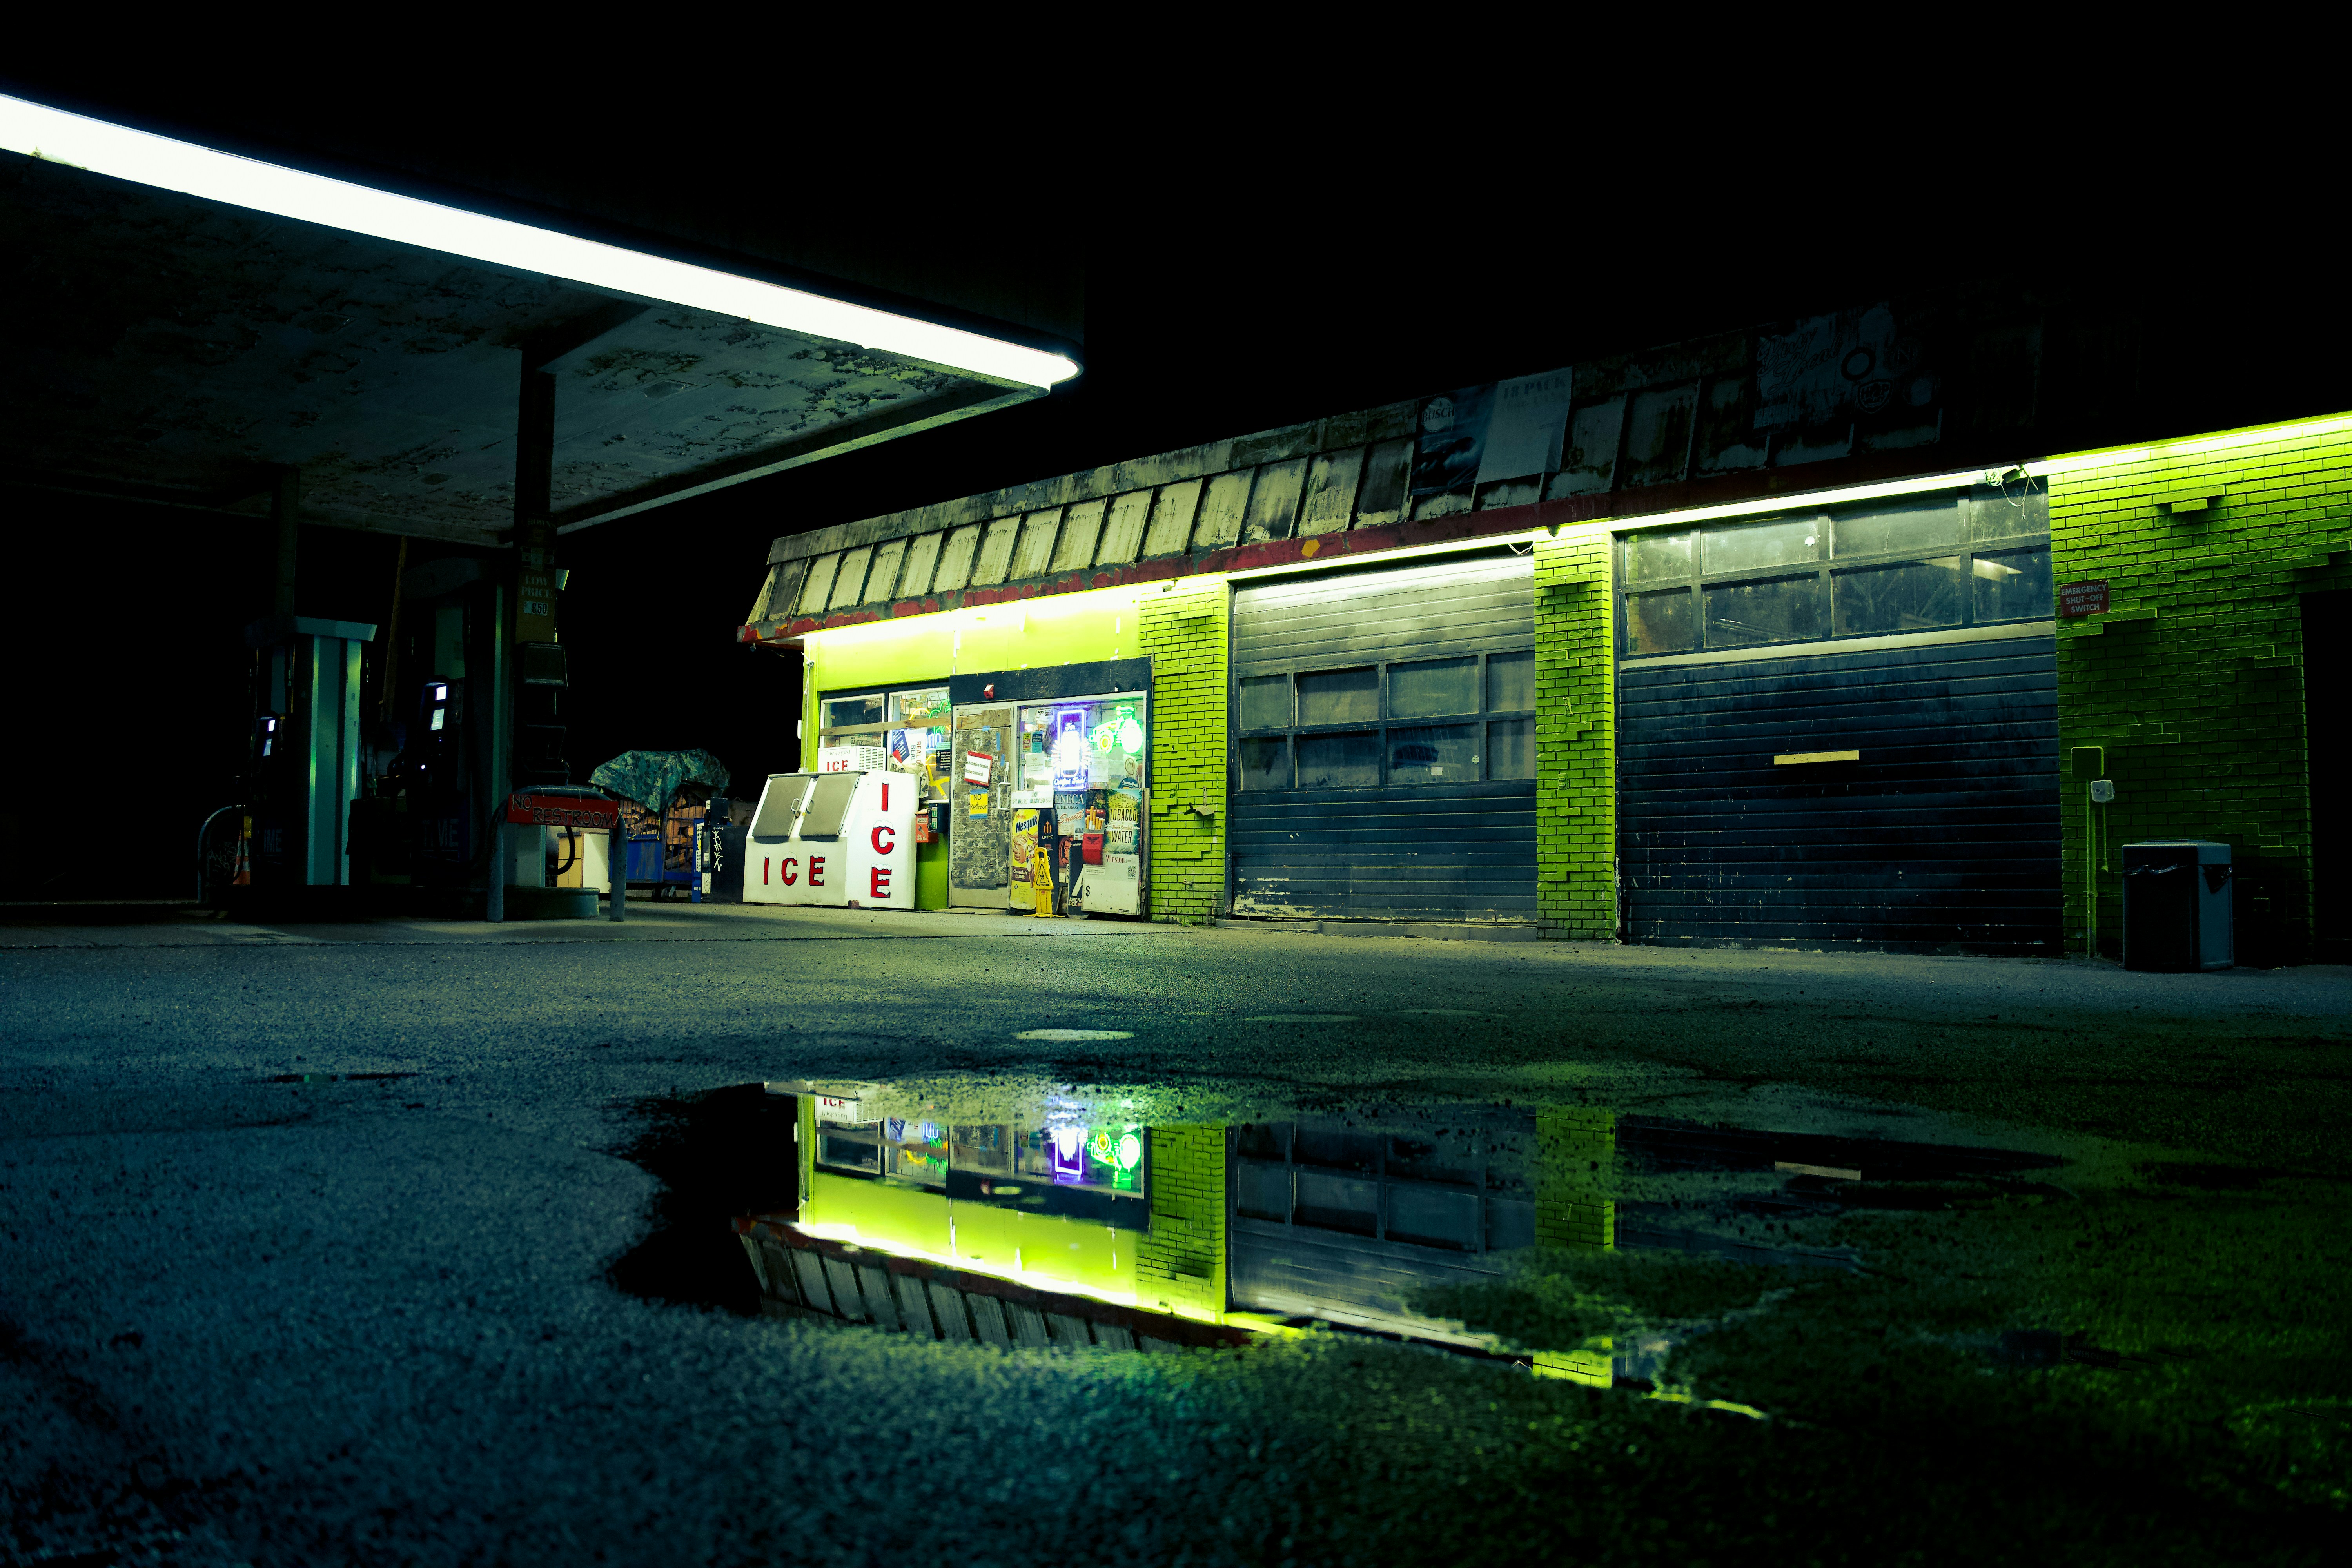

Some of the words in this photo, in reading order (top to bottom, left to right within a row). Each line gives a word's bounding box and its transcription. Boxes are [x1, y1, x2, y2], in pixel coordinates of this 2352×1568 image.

[1421, 406, 1455, 423] BUSCH
[2061, 584, 2107, 596] EMERGENCY
[2066, 593, 2103, 605] SHUT-OFF
[2071, 603, 2100, 613] SWITCH
[827, 760, 848, 772] ICE
[512, 794, 532, 811] NO
[1054, 794, 1085, 804] ENECA
[970, 802, 988, 810] Restroom
[533, 807, 614, 828] RESTROOM
[1058, 808, 1085, 825] Smooth
[1110, 808, 1137, 821] TOBACCO
[1016, 815, 1038, 833] Nesquik
[871, 778, 895, 898] ICE
[1112, 830, 1132, 843] WATER
[1105, 854, 1125, 864] Winston
[763, 851, 826, 886] ICE
[1085, 884, 1090, 897] $
